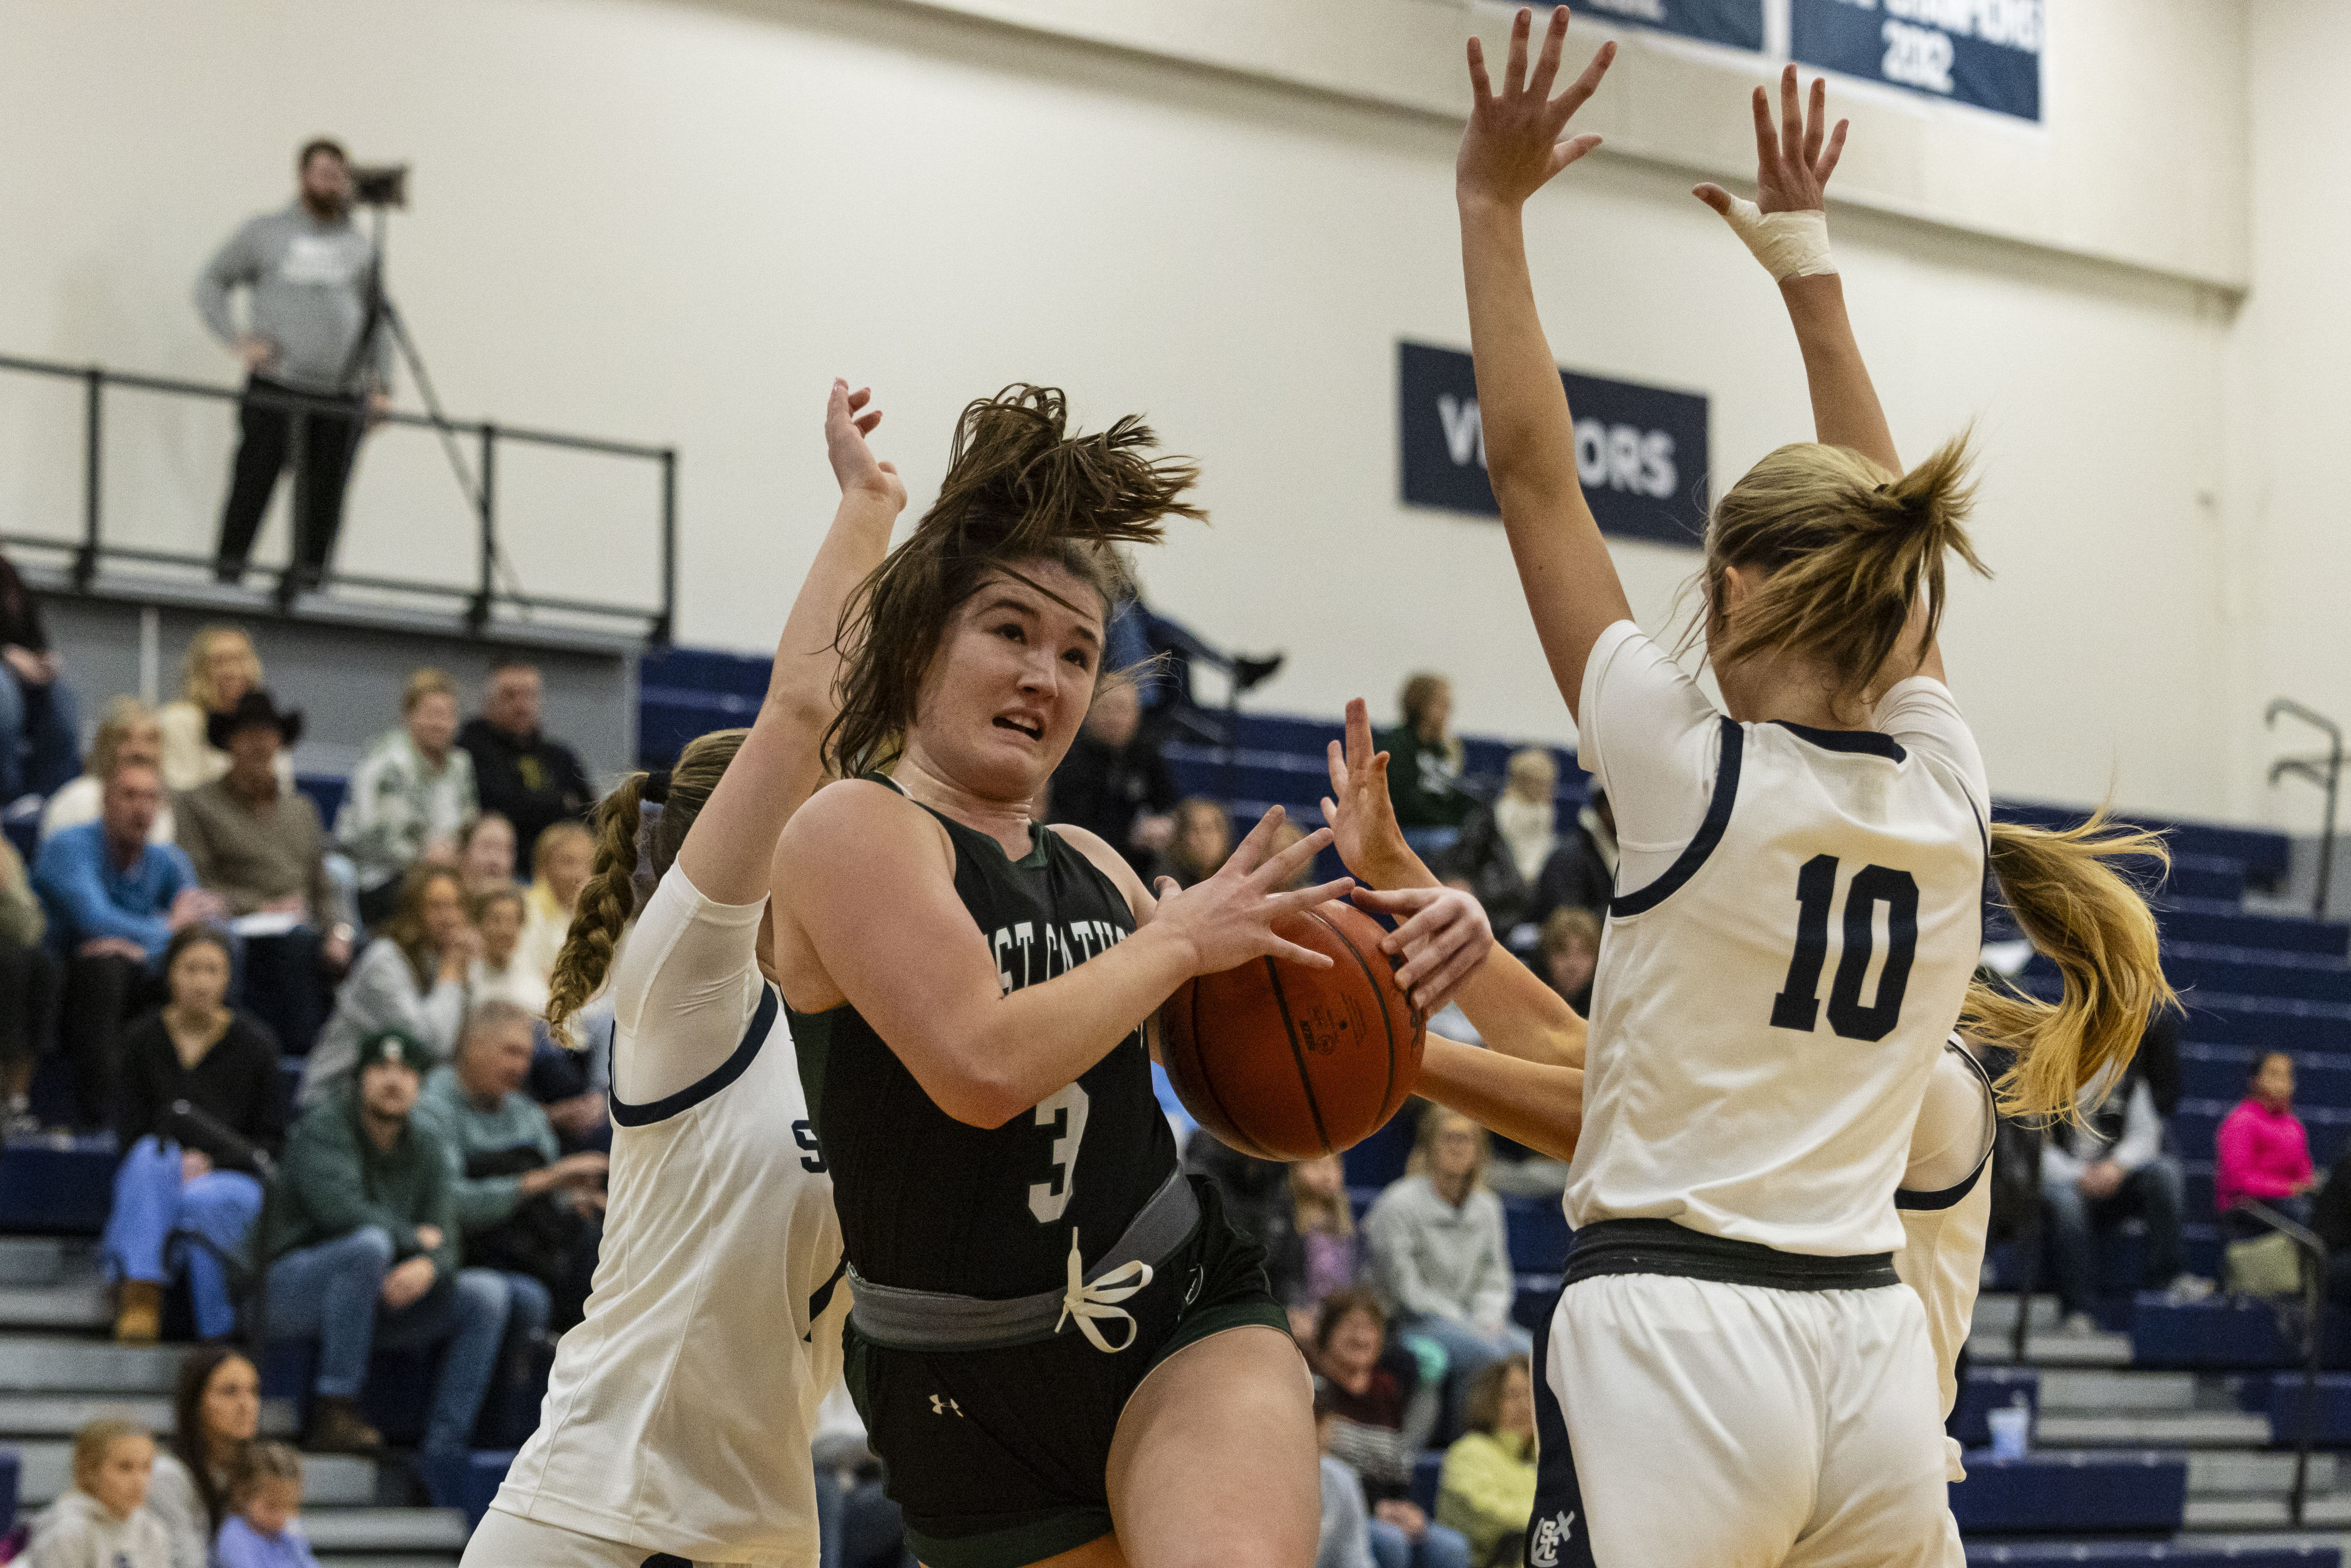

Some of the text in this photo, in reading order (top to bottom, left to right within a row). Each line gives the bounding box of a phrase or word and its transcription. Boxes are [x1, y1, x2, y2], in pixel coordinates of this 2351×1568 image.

[1438, 394, 1678, 498] VORS
[1769, 853, 1919, 1042] 10
[1028, 1081, 1089, 1223] 3
